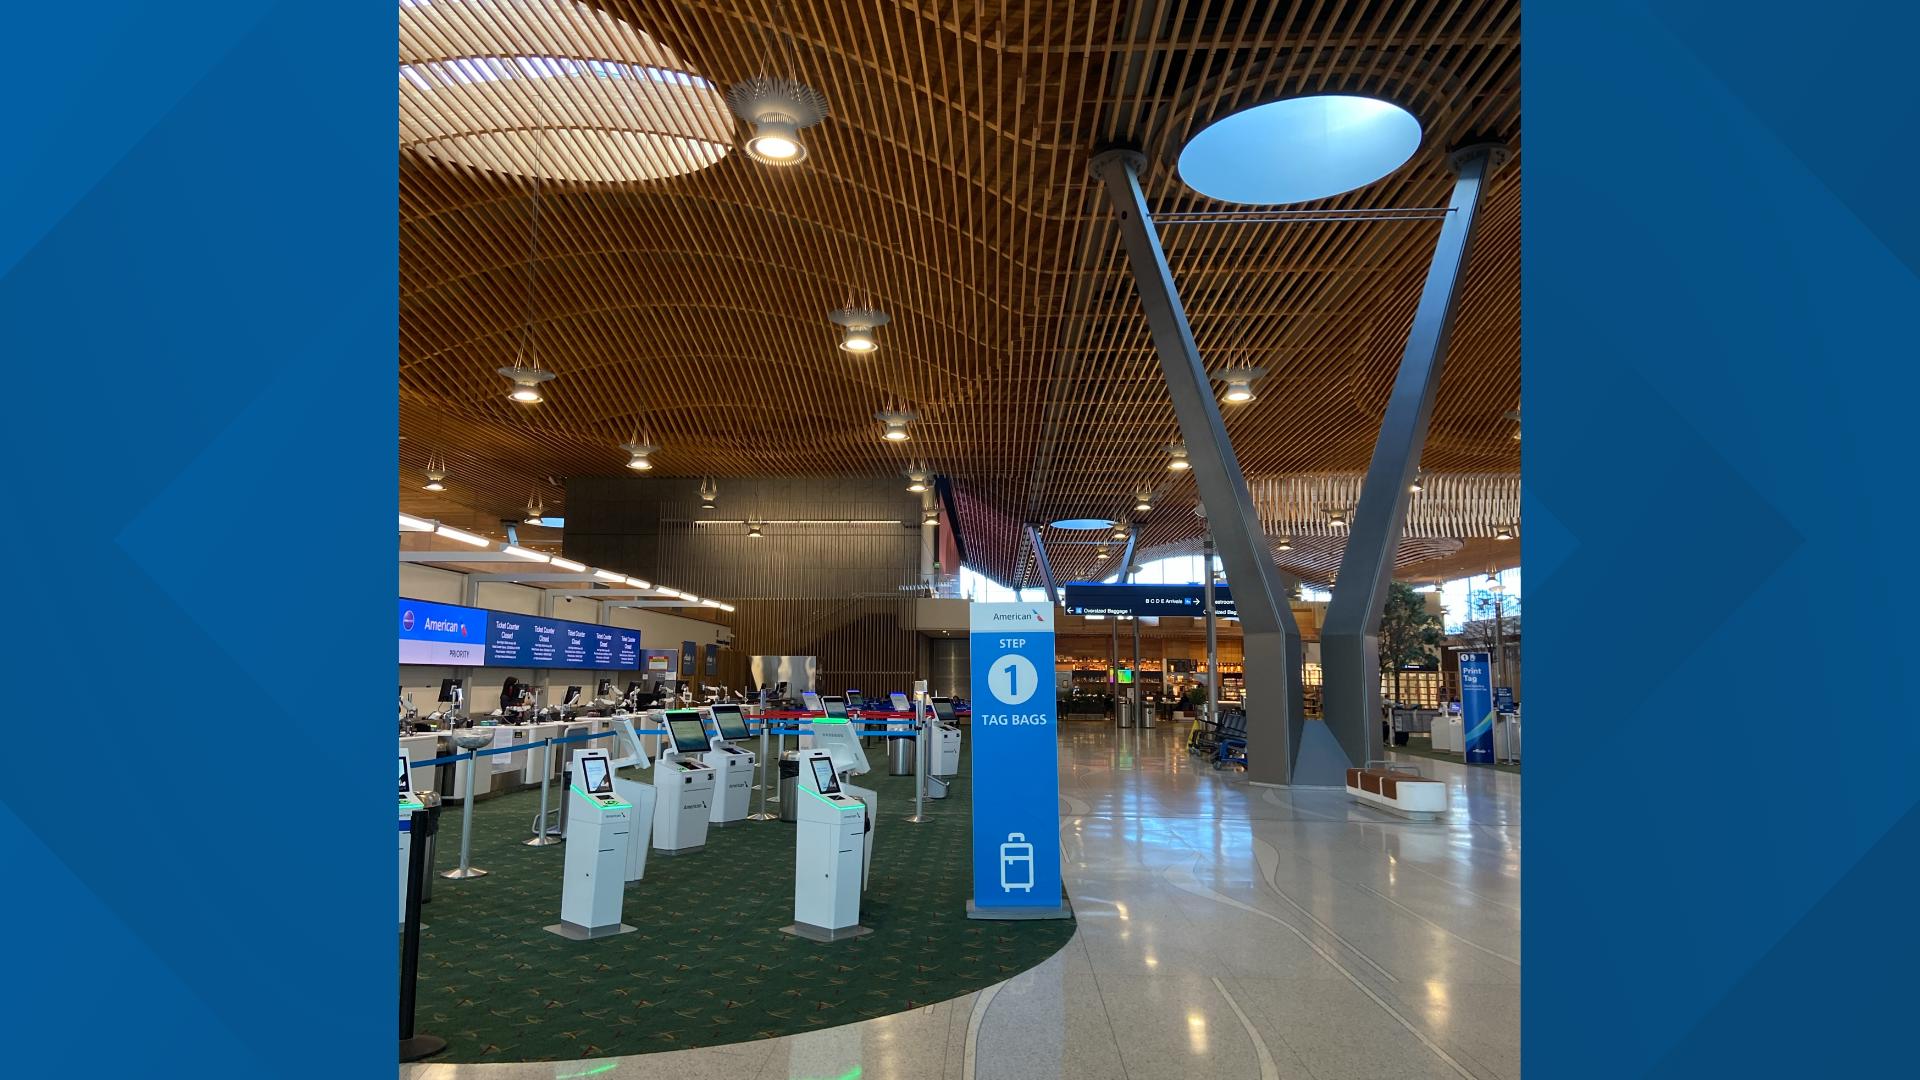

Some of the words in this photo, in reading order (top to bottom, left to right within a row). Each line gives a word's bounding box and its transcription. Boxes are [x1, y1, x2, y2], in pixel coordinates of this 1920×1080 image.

[993, 612, 1032, 620] American
[424, 617, 458, 632] American
[496, 620, 506, 629] Ticket
[1000, 639, 1026, 648] STEP
[449, 650, 469, 658] PRIORITY
[1004, 664, 1017, 696] 1
[982, 714, 1008, 726] TAG
[1012, 714, 1046, 725] BAGS
